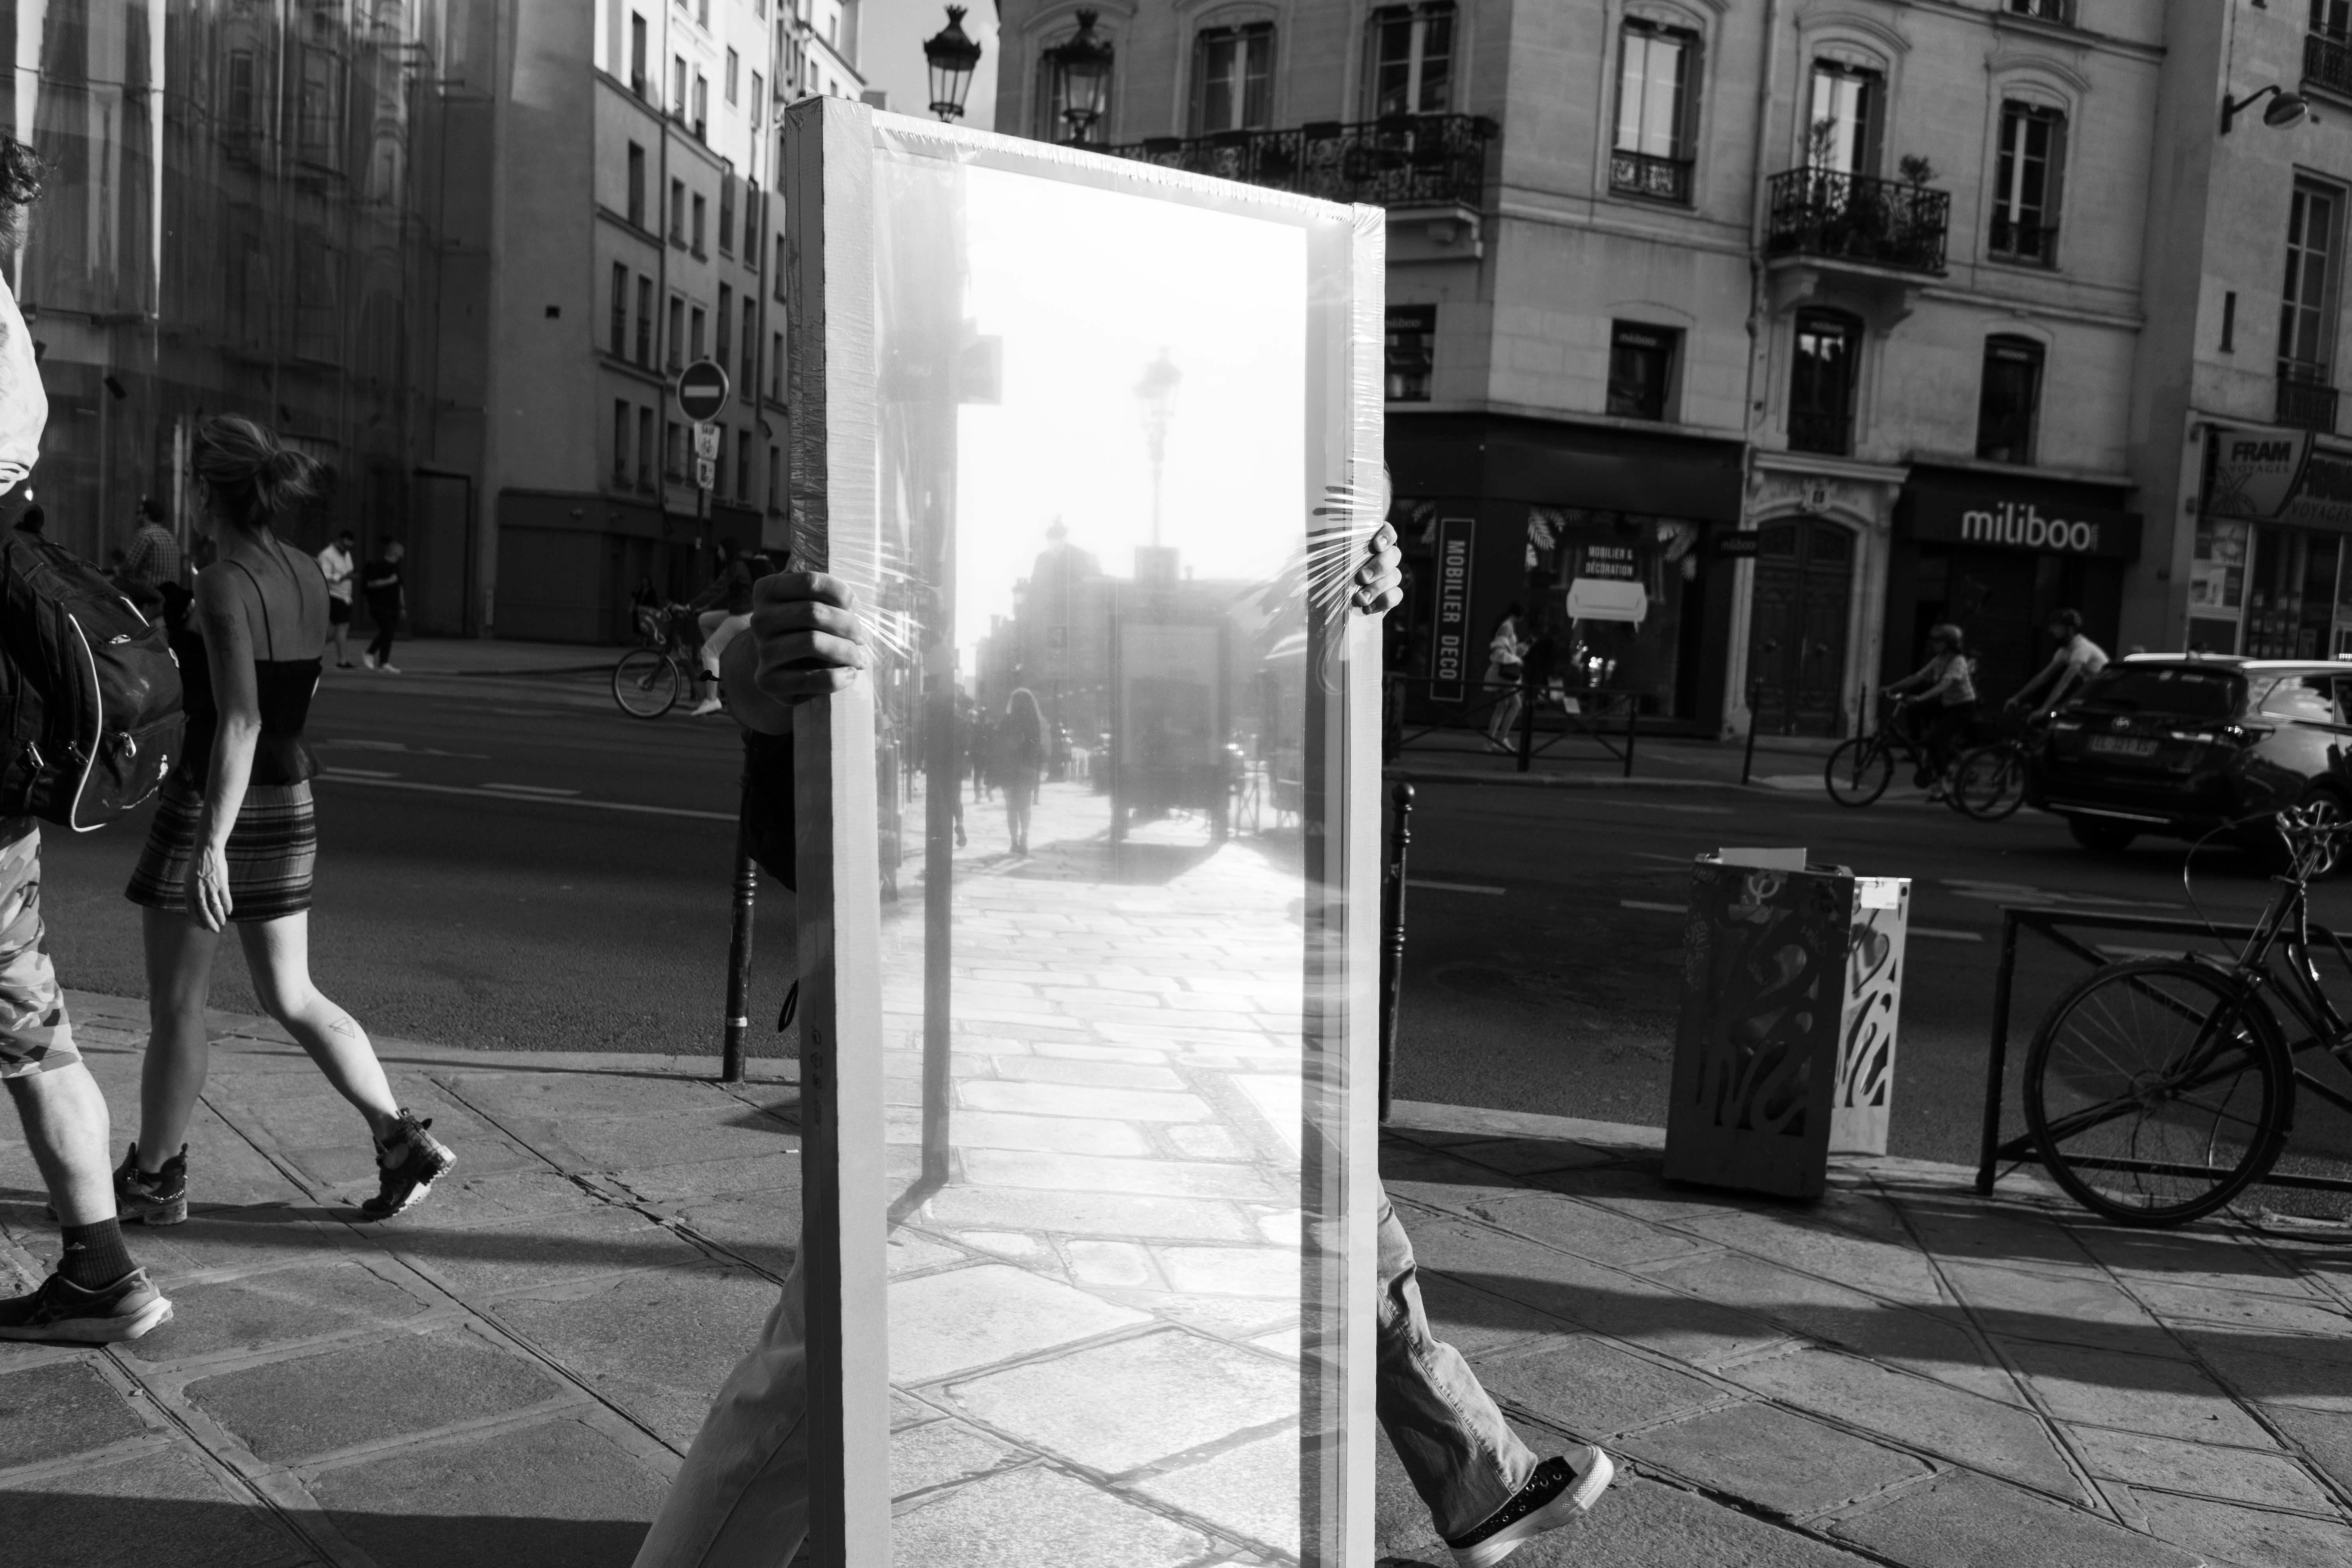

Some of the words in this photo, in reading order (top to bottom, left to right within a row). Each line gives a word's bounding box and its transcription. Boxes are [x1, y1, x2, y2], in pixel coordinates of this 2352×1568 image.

[2231, 441, 2292, 461] FRAM
[2229, 463, 2288, 474] VOYAGES
[2292, 500, 2351, 524] VOYAGES
[1961, 500, 2091, 552] miliboo
[1588, 544, 1625, 560] MOBILIER
[1626, 547, 1633, 561] &
[1585, 559, 1633, 577] DÉCORATION
[1443, 540, 1465, 623] MOBILIER
[1439, 635, 1460, 679] DECO
